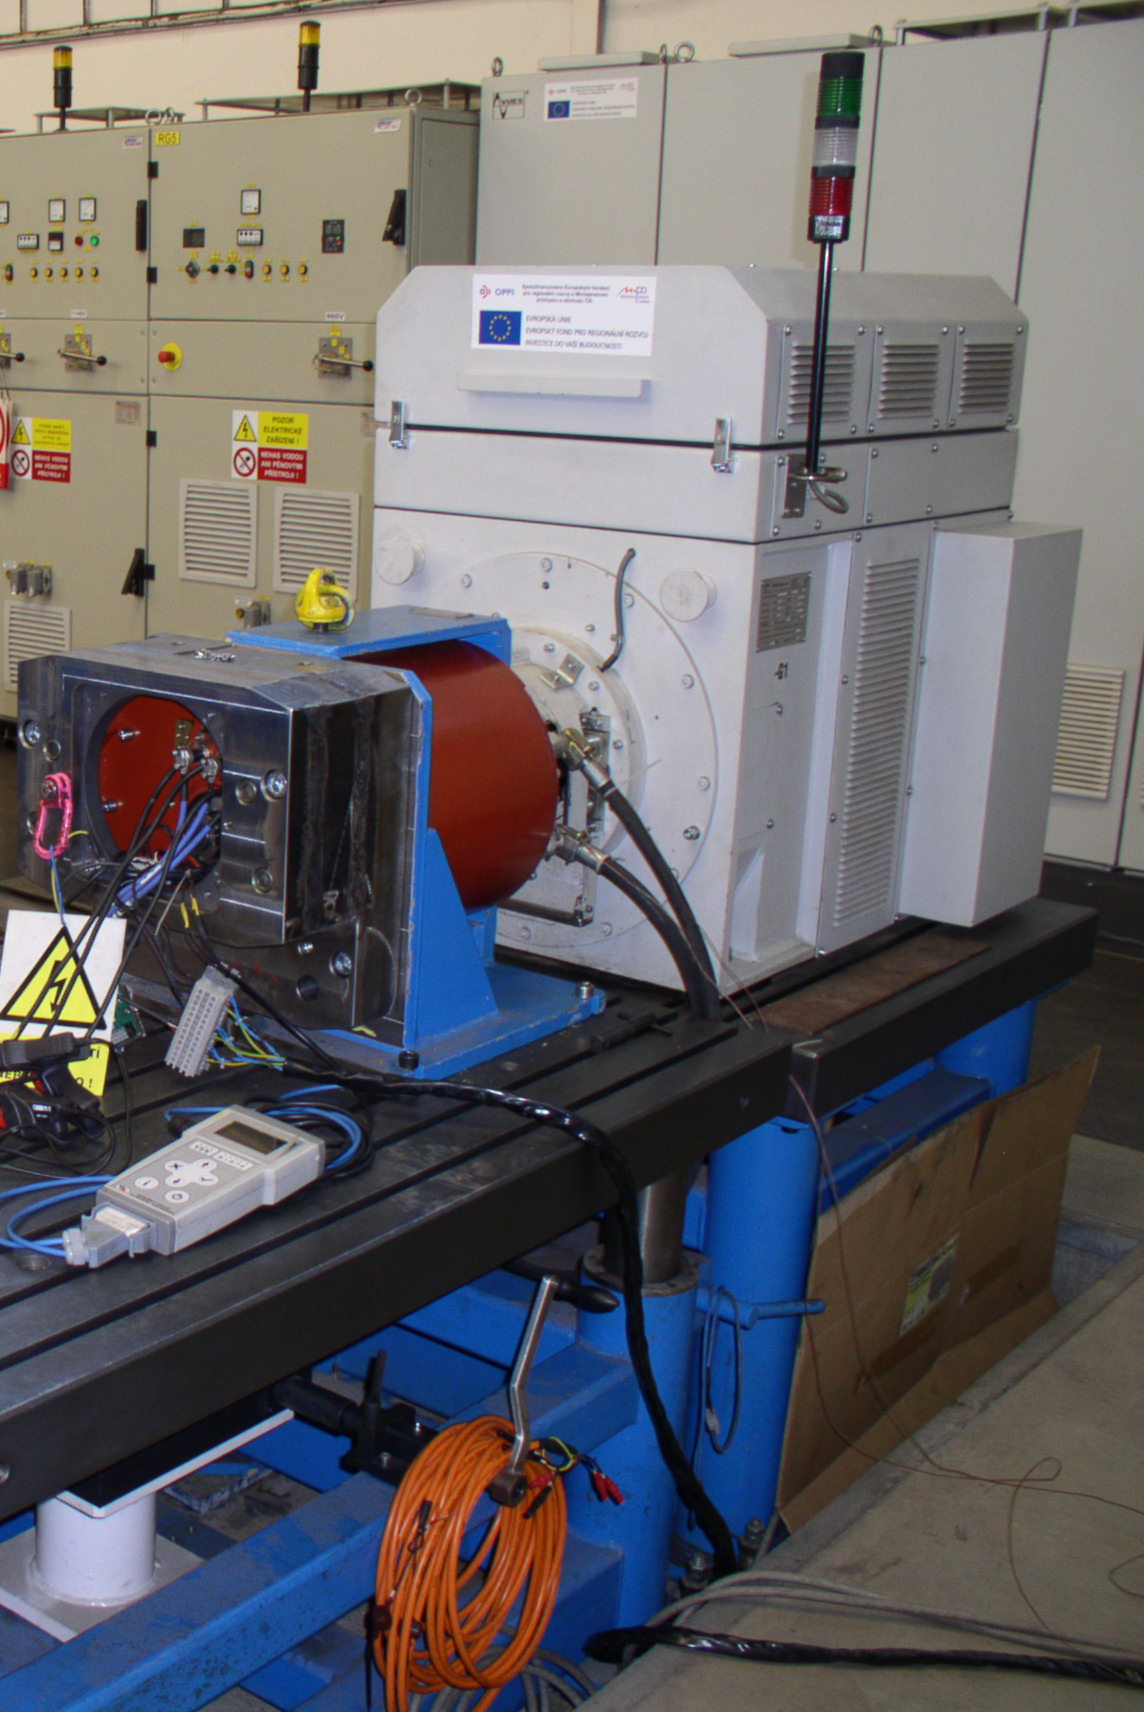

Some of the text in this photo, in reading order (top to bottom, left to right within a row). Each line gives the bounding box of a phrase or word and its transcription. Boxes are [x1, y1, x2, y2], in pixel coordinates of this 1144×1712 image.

[495, 288, 515, 296] OPPI
[263, 425, 302, 435] ELEKTRICKÉ
[260, 451, 304, 461] NEHAS VODOU
